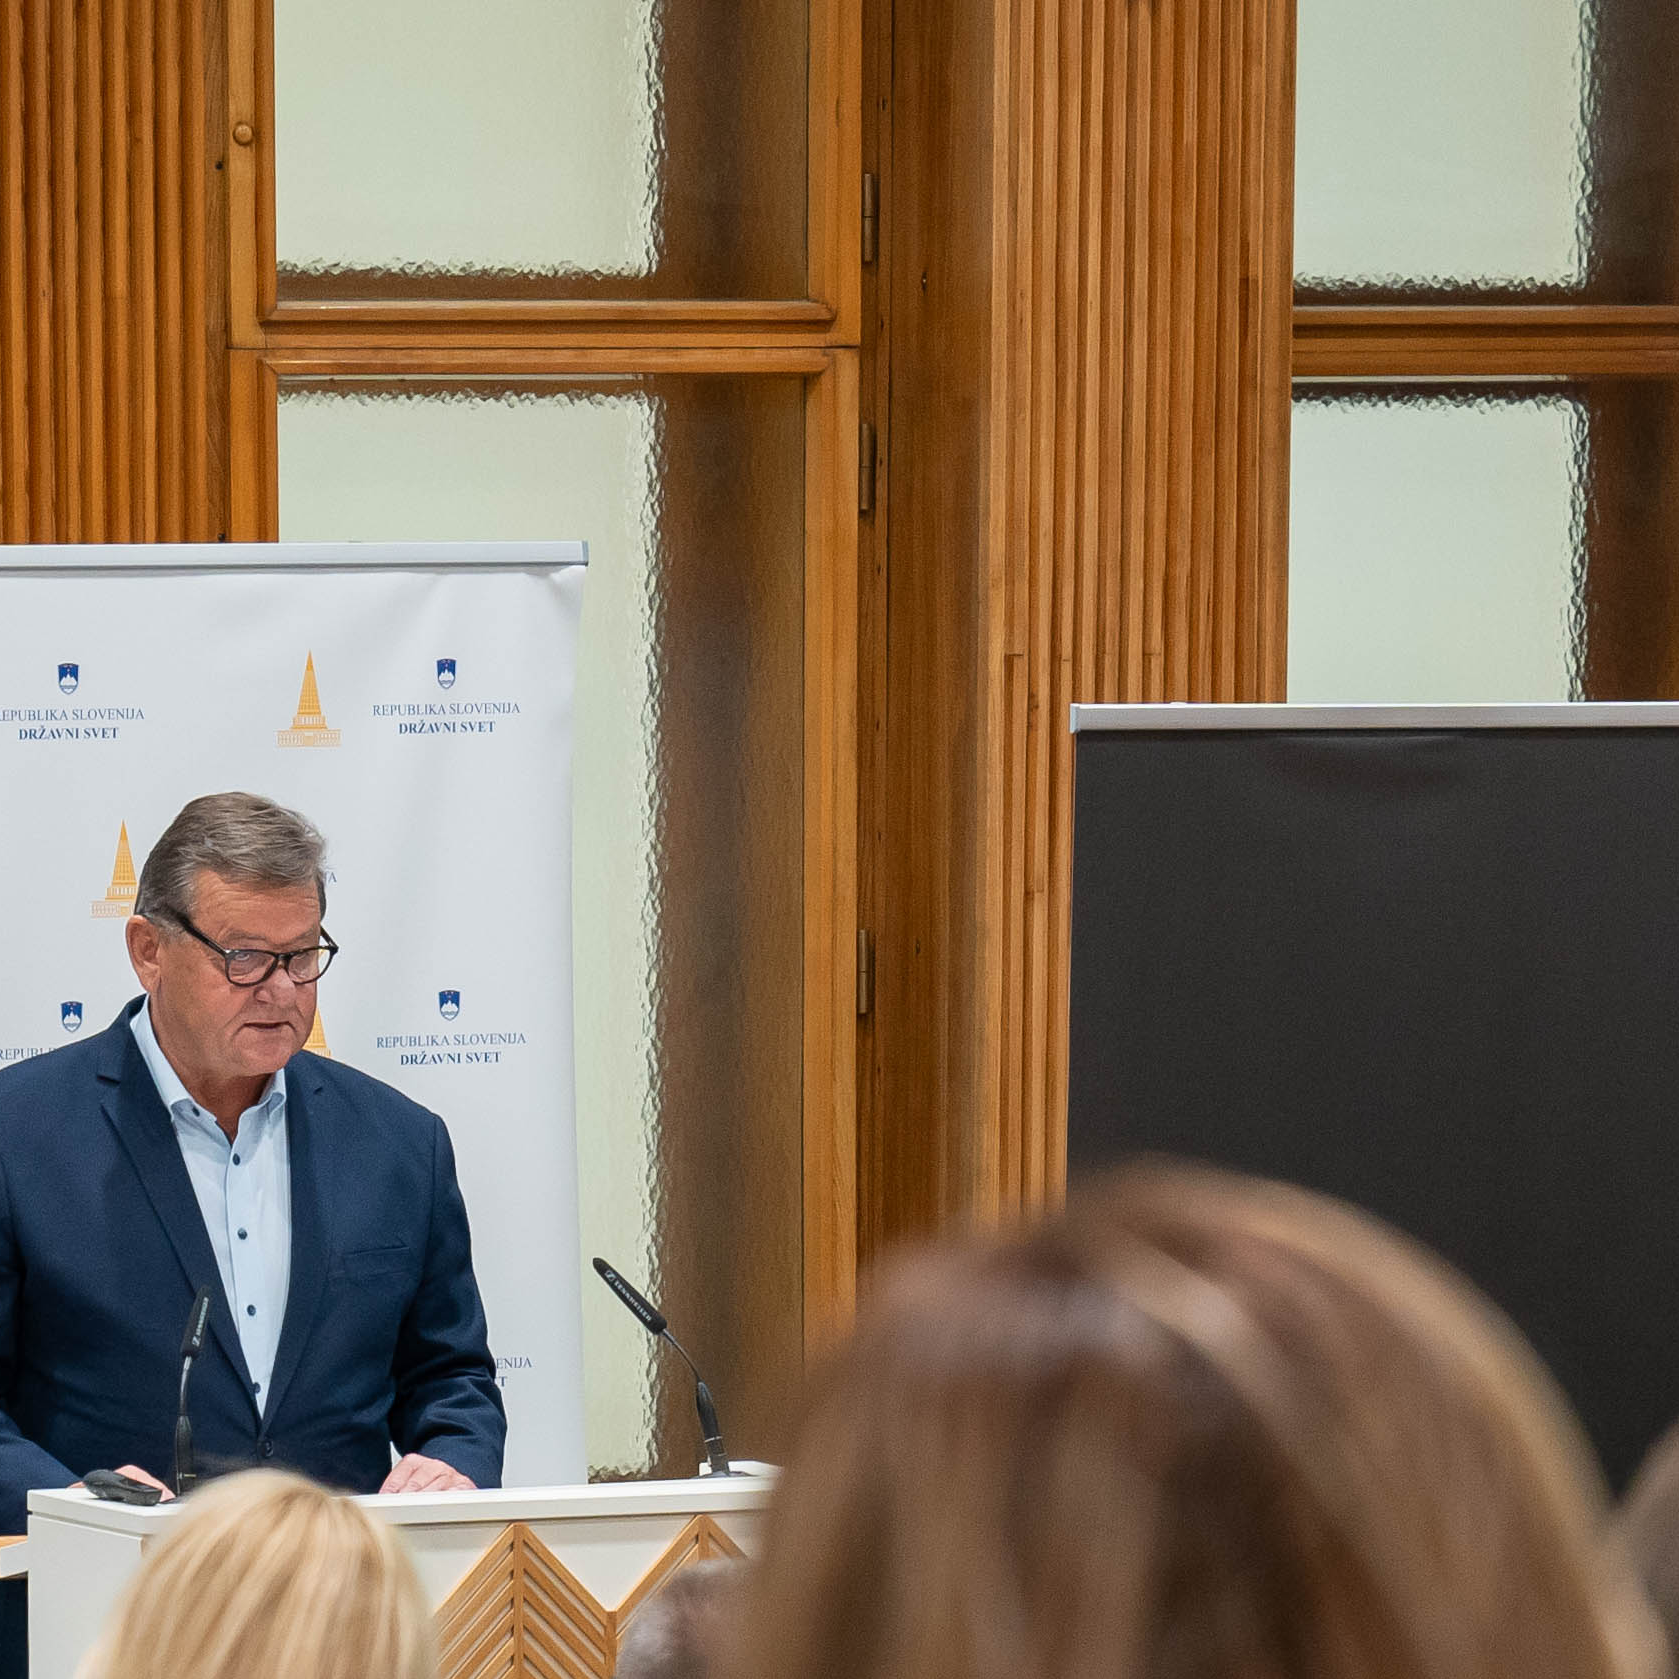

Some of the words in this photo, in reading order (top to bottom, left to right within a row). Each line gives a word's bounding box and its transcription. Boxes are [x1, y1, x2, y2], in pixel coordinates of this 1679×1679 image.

[71, 707, 145, 721] SLOVENIJA
[372, 703, 447, 717] REPUBLIKA
[448, 702, 521, 715] SLOVENIJA
[18, 725, 80, 741] DRŽAVNI
[83, 727, 117, 739] SVET
[398, 719, 457, 735] DRŽAVNI
[460, 720, 494, 733] SVET
[376, 1034, 450, 1049] REPUBLIKA
[453, 1032, 527, 1046] SLOVENIJA
[400, 1050, 461, 1066] DRŽAVNI
[465, 1051, 499, 1063] SVET
